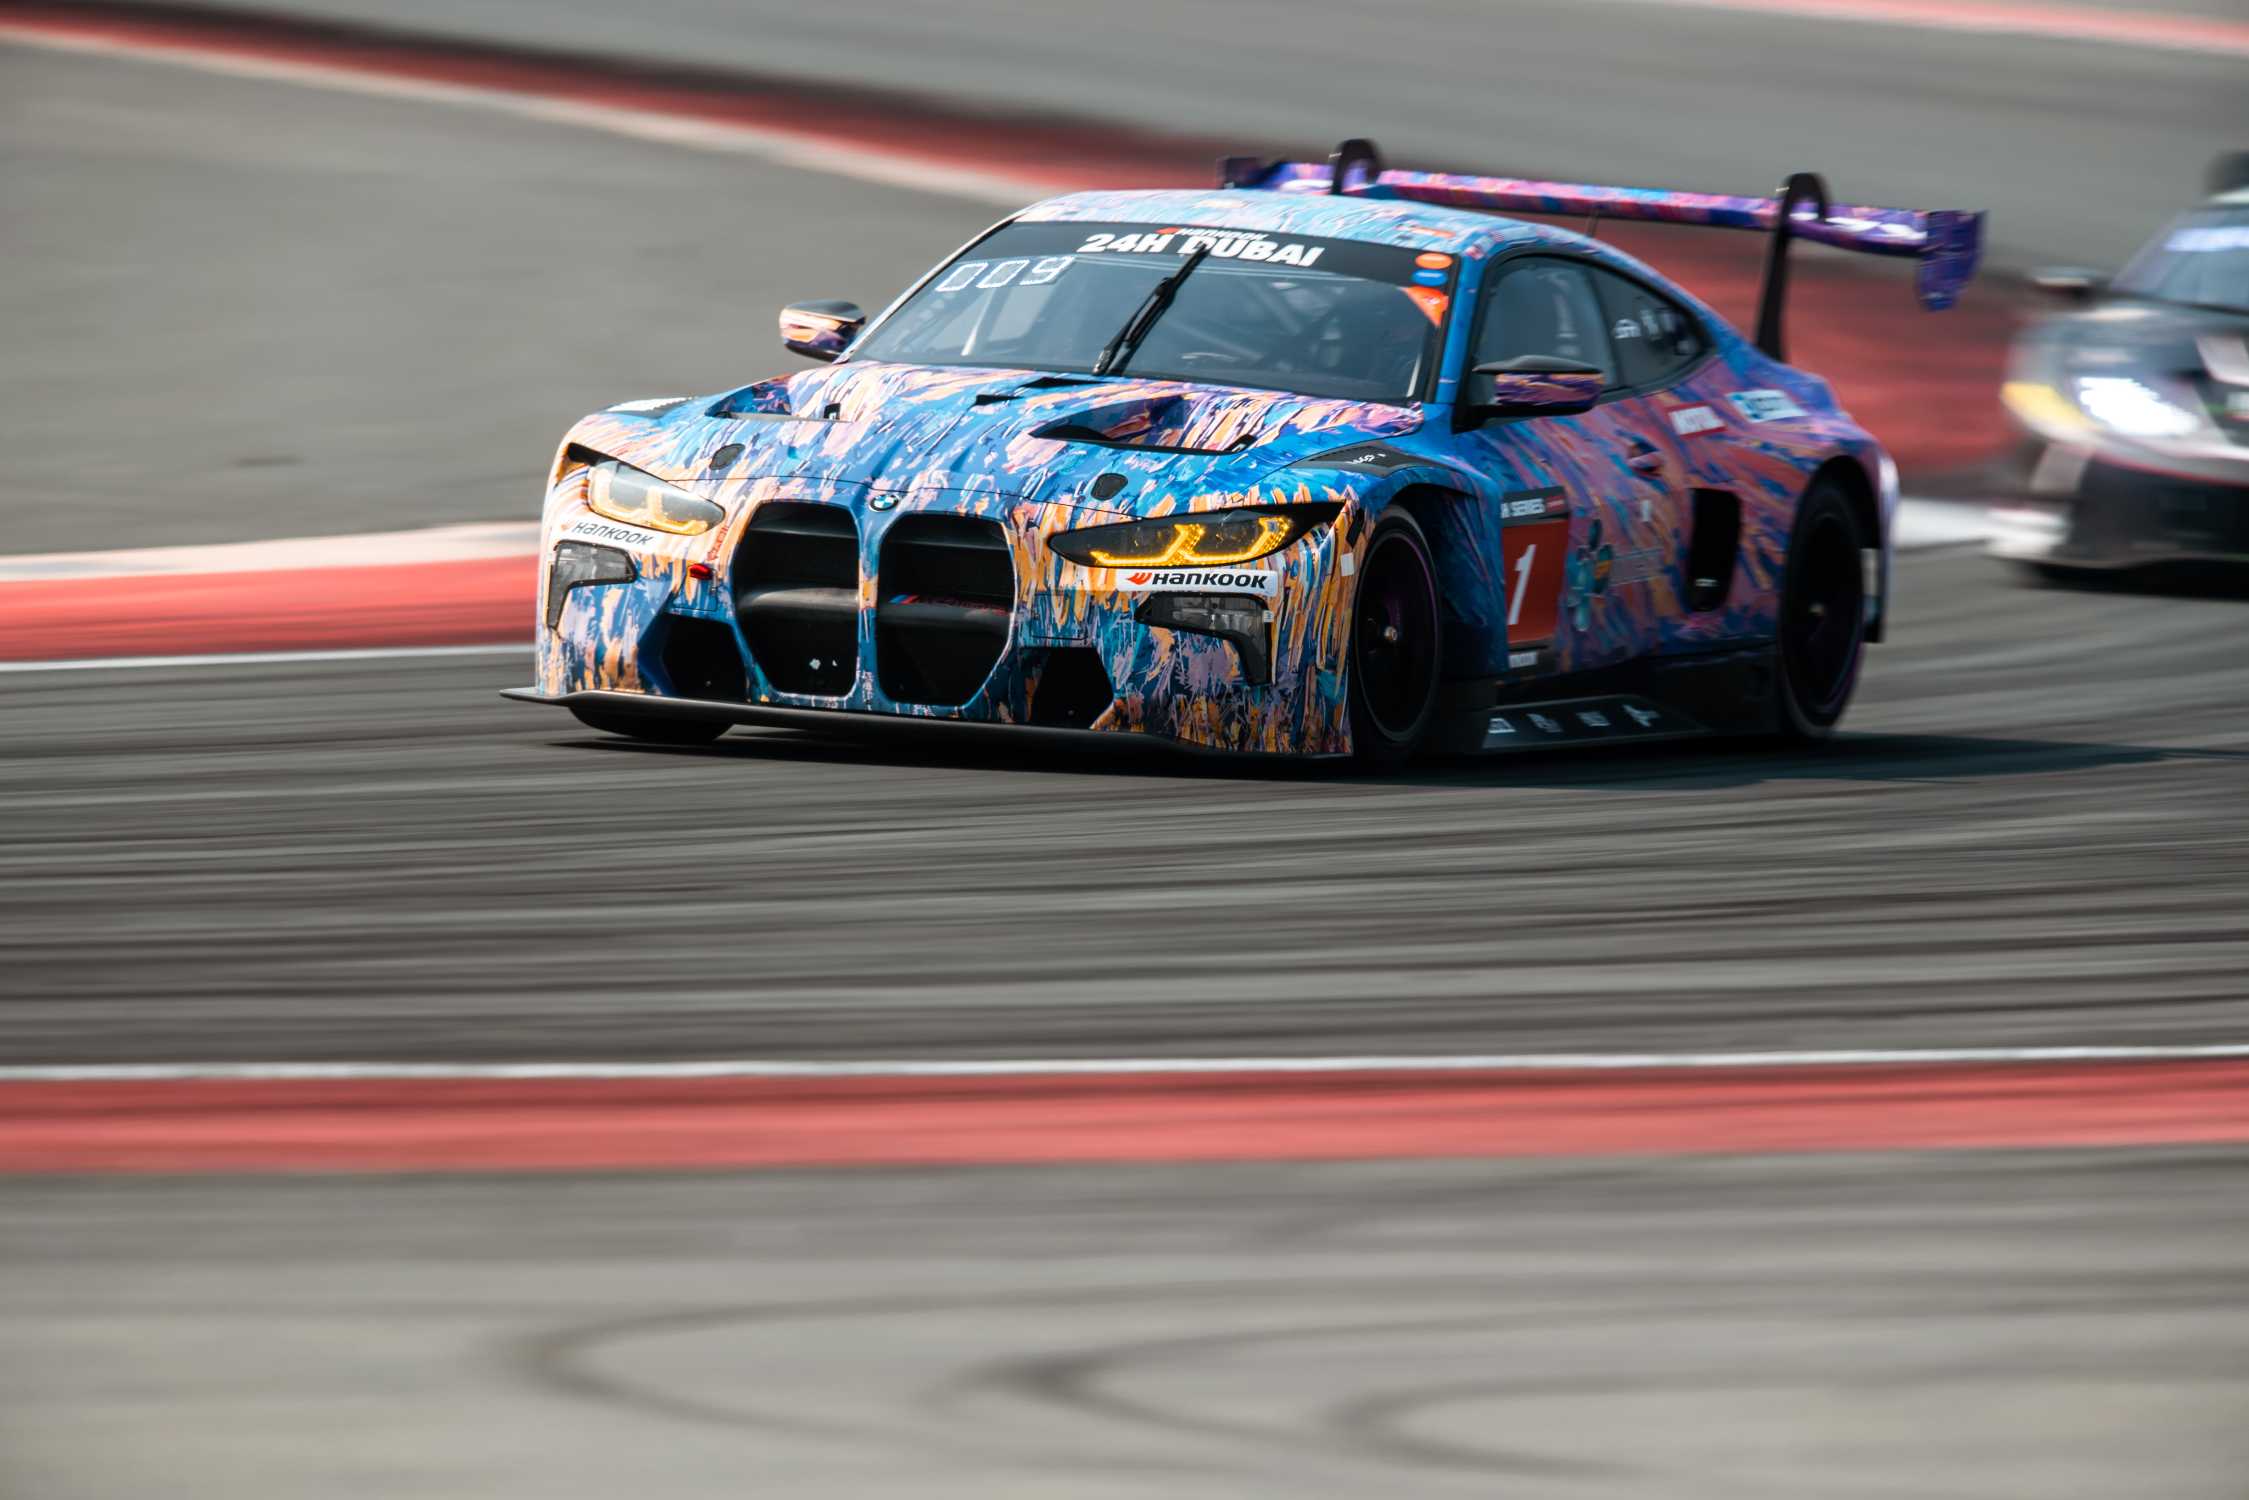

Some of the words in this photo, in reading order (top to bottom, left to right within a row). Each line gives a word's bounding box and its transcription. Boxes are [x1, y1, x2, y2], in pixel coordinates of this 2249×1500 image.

[1077, 233, 1175, 253] 24H
[1177, 236, 1325, 267] DUBAI
[934, 256, 1076, 292] 009
[1507, 544, 1537, 626] 1
